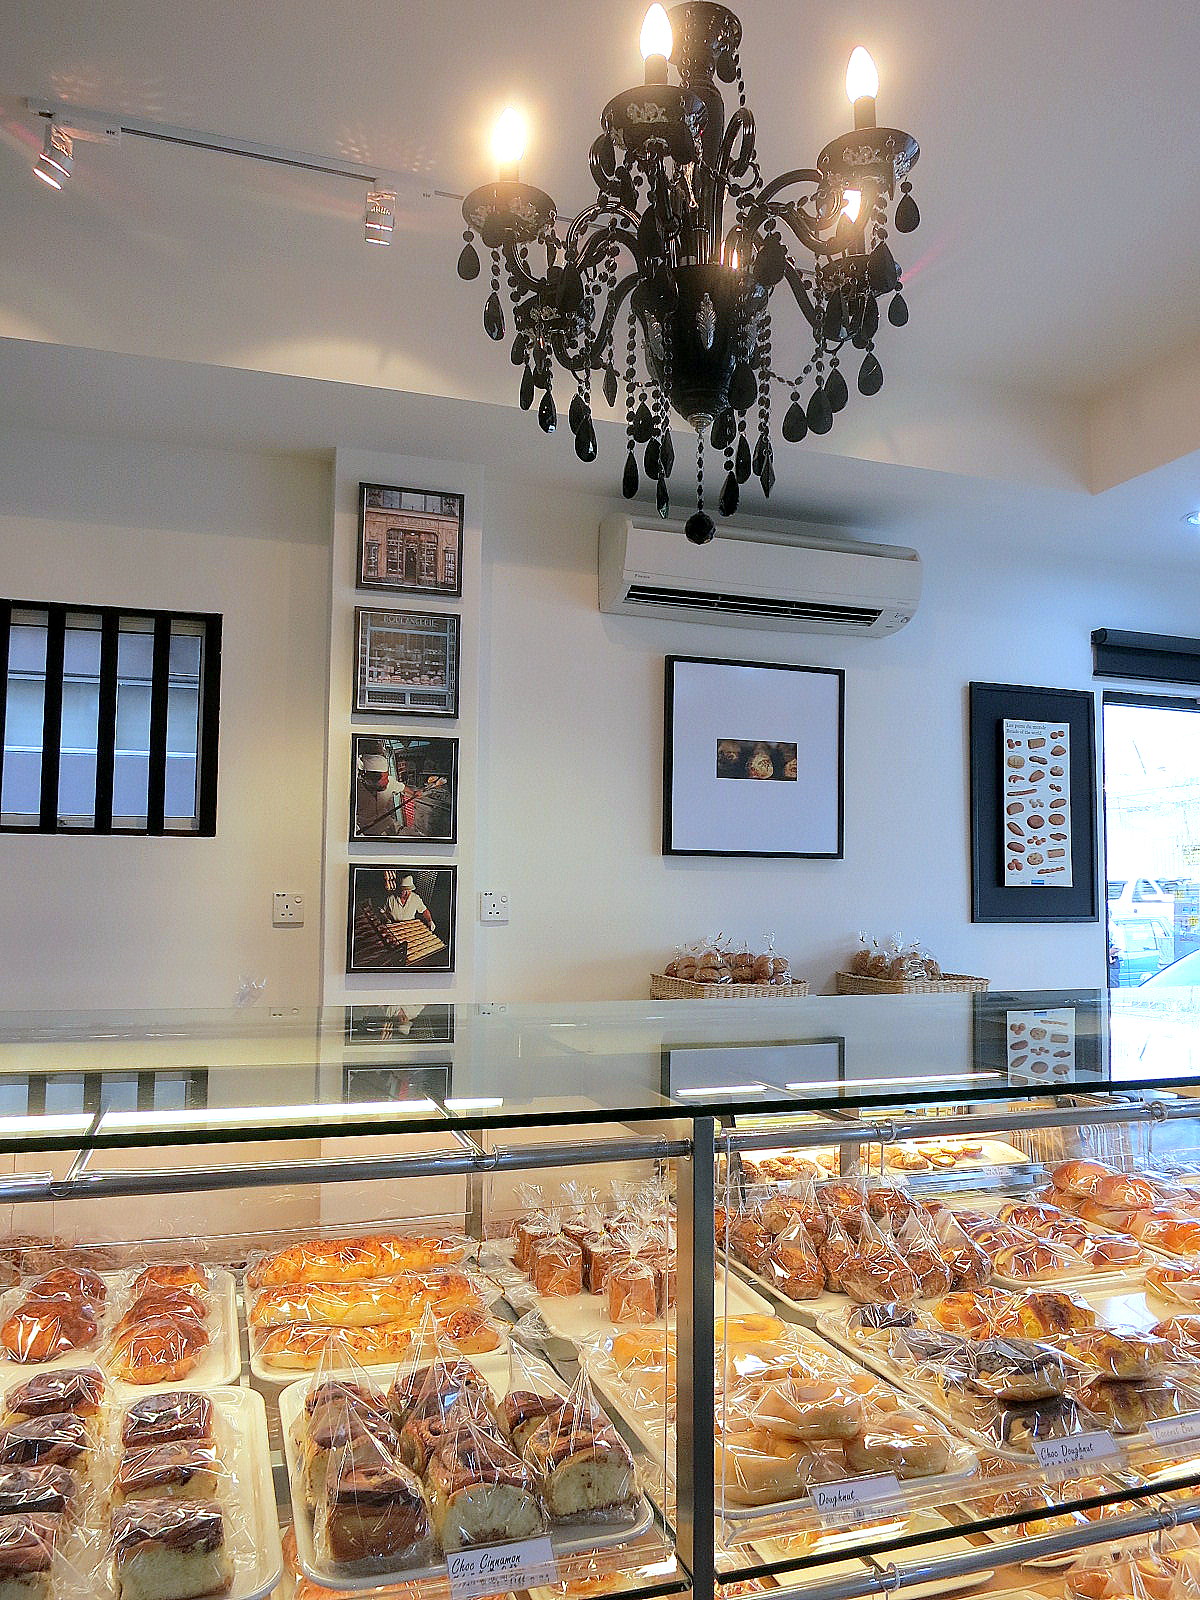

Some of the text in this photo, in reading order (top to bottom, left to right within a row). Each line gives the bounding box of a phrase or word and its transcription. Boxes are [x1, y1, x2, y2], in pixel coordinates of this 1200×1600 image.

[1040, 1447, 1059, 1461] Choc
[1060, 1442, 1094, 1457] Doughnut
[818, 1489, 856, 1508] Doughnut
[451, 1557, 475, 1575] Choc
[479, 1553, 521, 1569] Cinnamon
